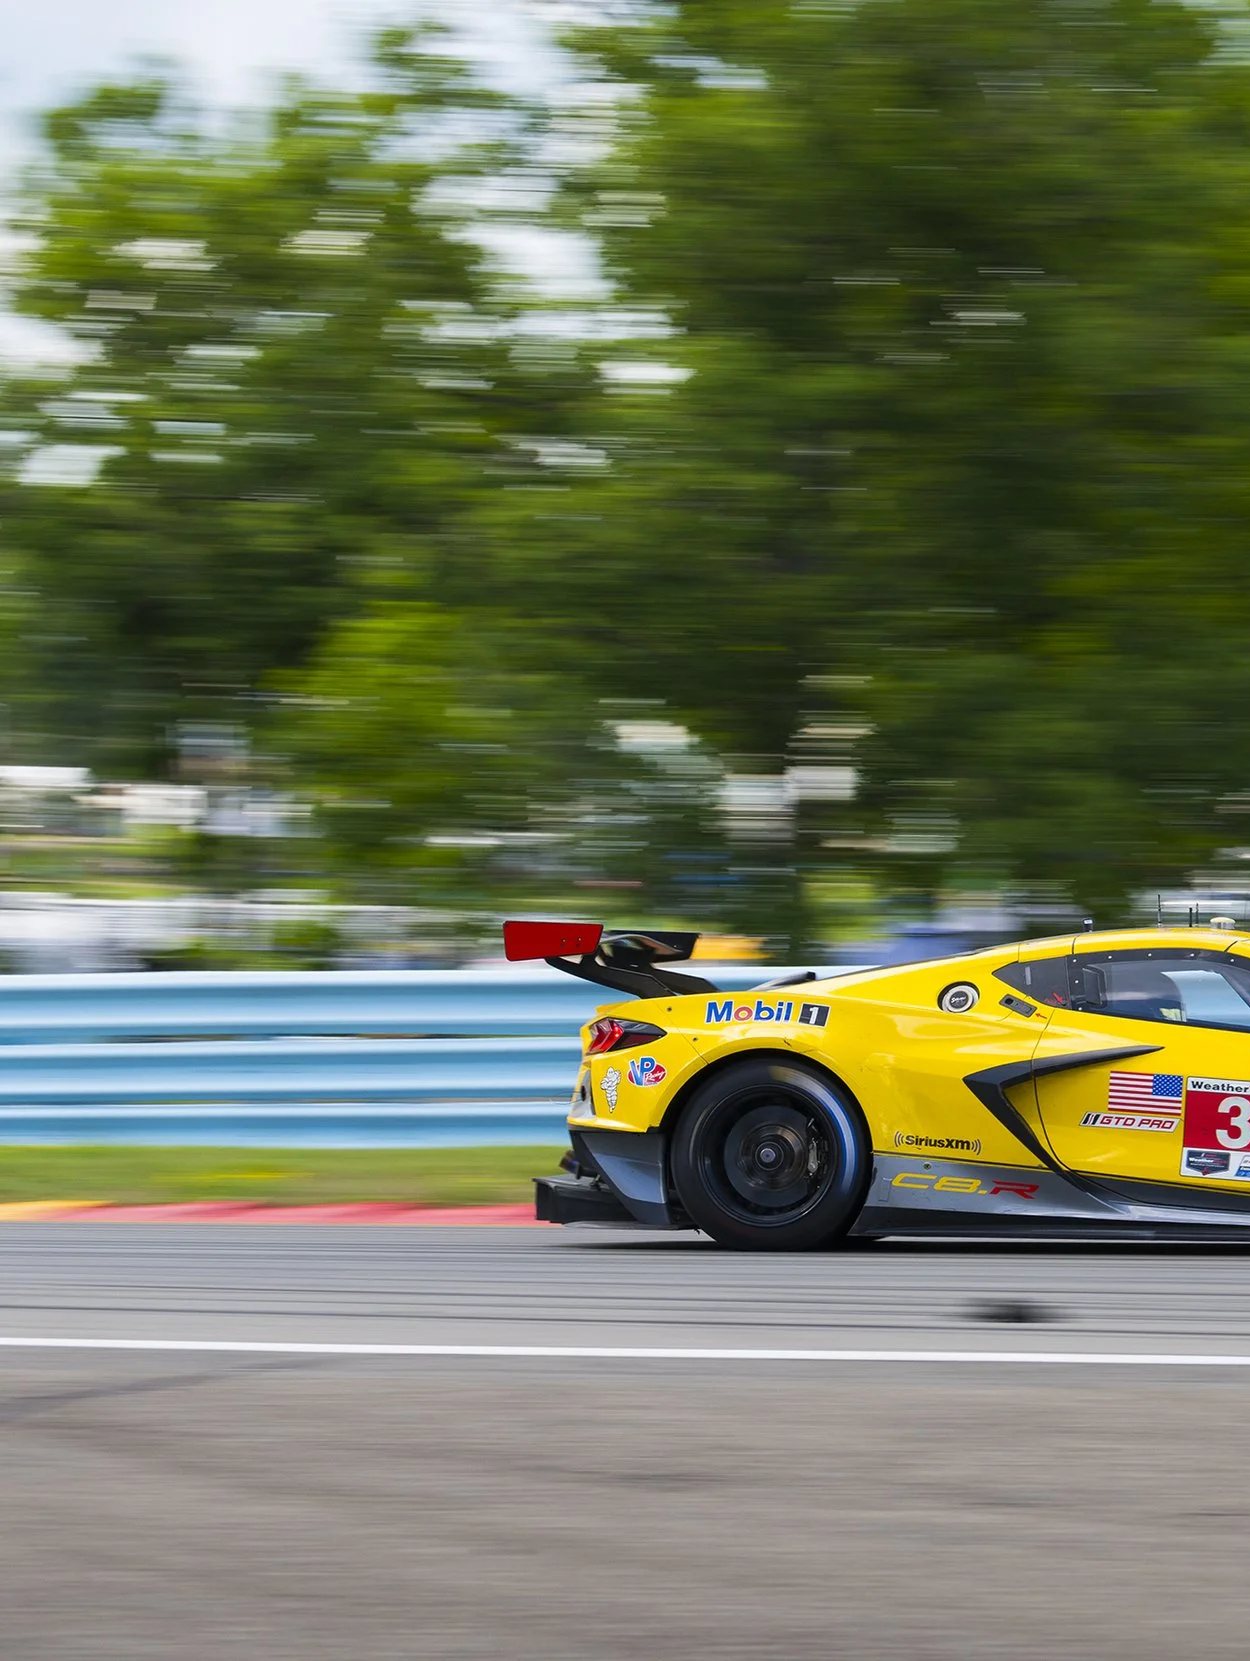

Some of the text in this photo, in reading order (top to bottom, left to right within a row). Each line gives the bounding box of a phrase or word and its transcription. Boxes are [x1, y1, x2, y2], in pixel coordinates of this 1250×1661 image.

[705, 1000, 819, 1025] Mobil 1
[629, 1056, 656, 1086] VP
[1100, 1115, 1175, 1129] GTD PRO
[891, 1172, 1040, 1199] C8.R
